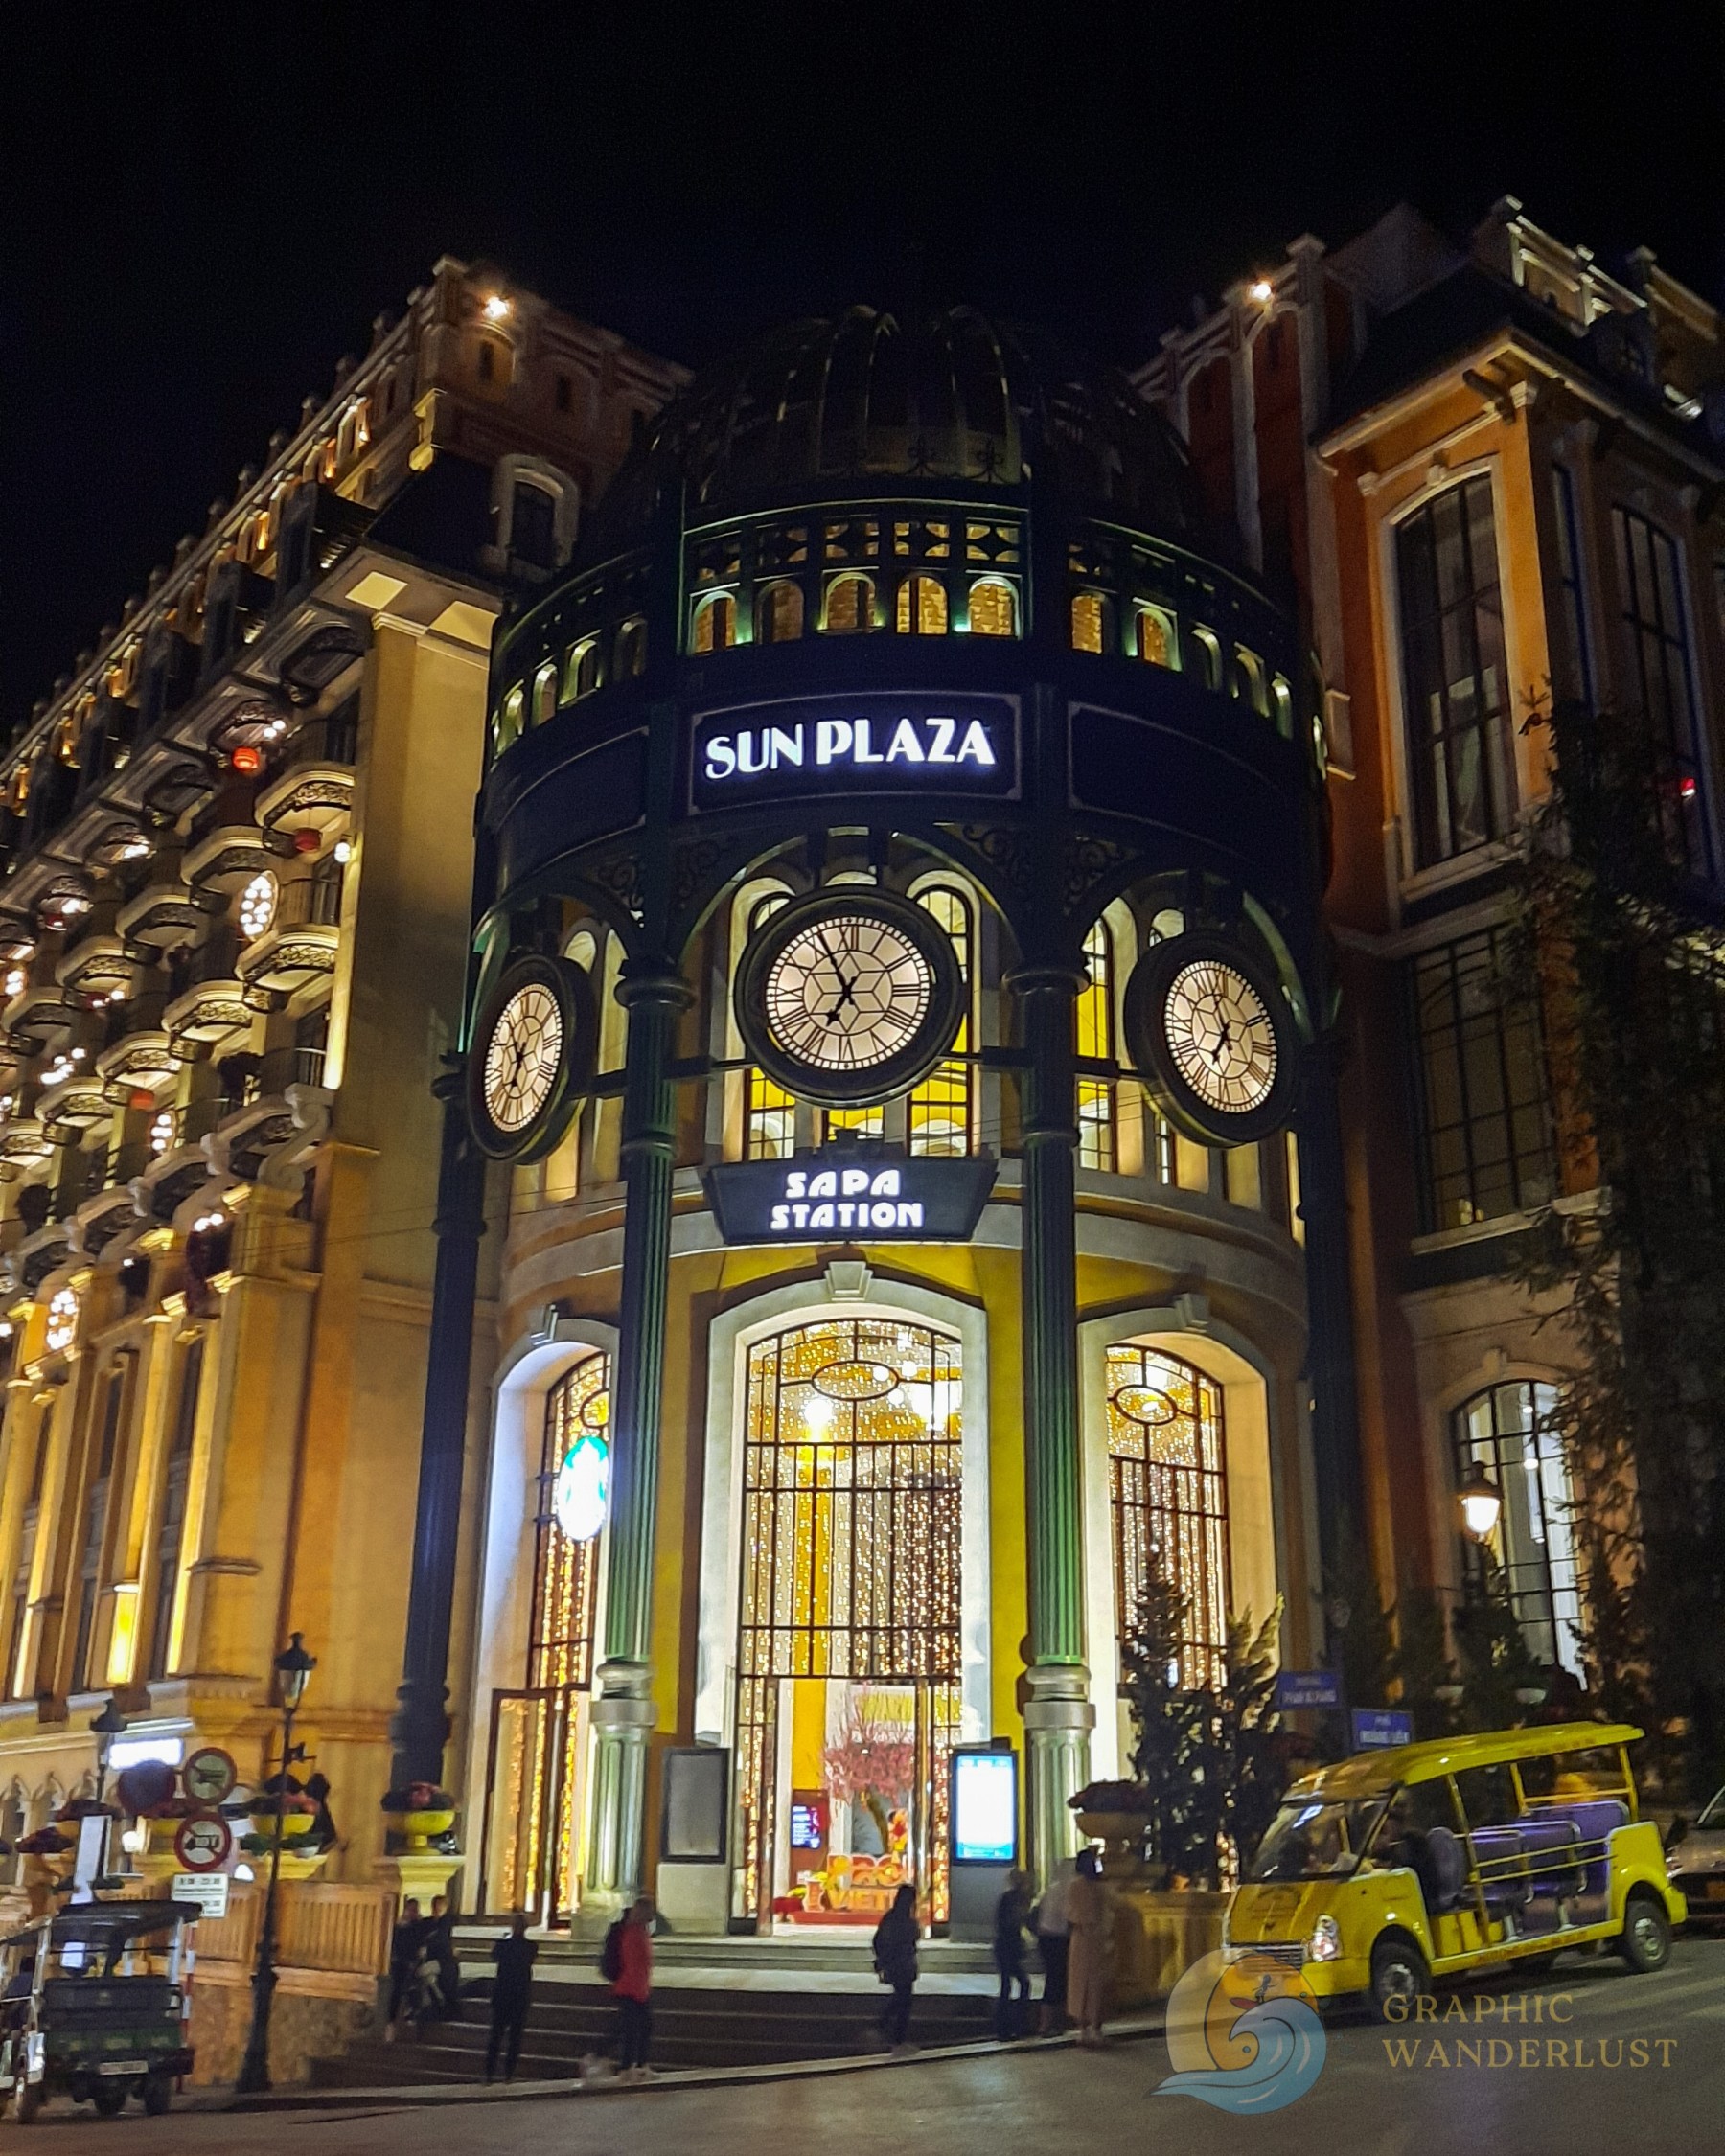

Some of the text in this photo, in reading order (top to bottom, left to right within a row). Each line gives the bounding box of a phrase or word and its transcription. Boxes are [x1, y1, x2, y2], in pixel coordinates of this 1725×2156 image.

[705, 718, 996, 779] SUN PLAZA
[785, 1169, 901, 1199] SAPA
[770, 1202, 923, 1230] STATION
